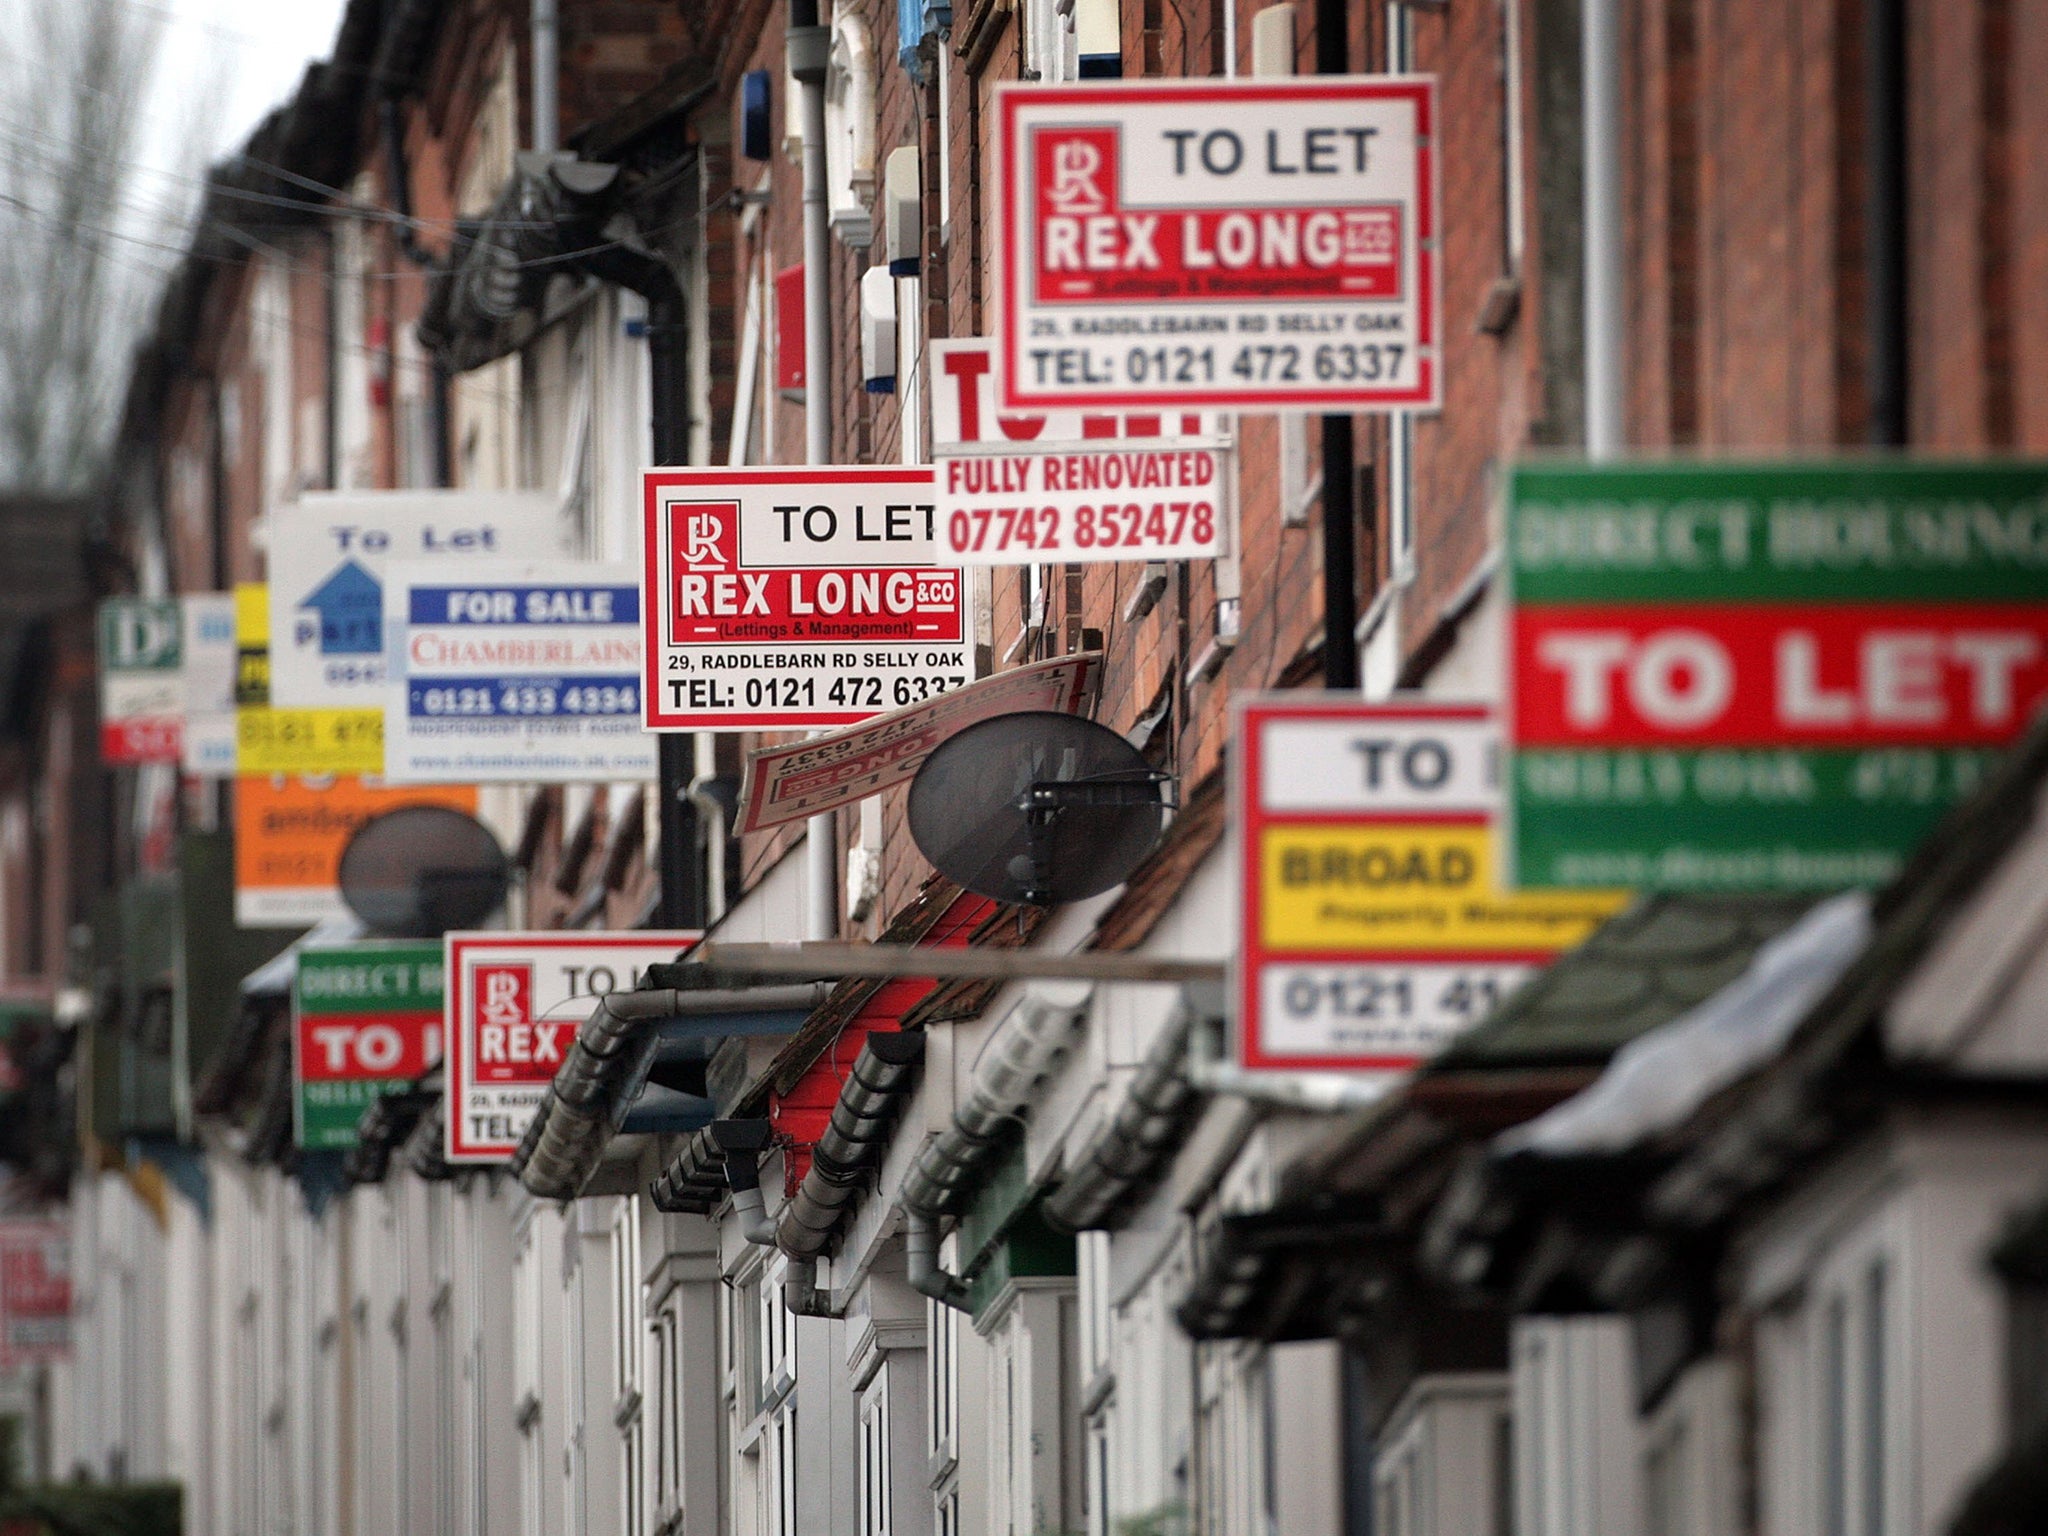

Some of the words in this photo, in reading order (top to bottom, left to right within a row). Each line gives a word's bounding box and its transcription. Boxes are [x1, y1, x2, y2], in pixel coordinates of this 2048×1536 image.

[1163, 129, 1245, 176] TO
[1266, 126, 1378, 174] LET
[1043, 213, 1161, 271] REX
[1181, 210, 1341, 268] LONG
[1029, 349, 1114, 385] TEL:
[1127, 347, 1216, 383] 0121
[1232, 346, 1300, 382] 472
[1315, 344, 1405, 381] 6337
[947, 456, 1031, 495] FULLY
[1043, 450, 1214, 491] RENOVATED
[330, 525, 390, 550] To
[421, 525, 497, 552] Let
[773, 506, 837, 543] TO
[855, 505, 936, 542] LET
[949, 506, 1060, 553] 07742
[1073, 501, 1214, 548] 852478
[1518, 502, 1749, 570] DIRECT
[447, 591, 516, 622] FOR
[525, 591, 614, 622] SALE
[680, 574, 772, 618] REX
[790, 572, 914, 617] LONG
[916, 582, 955, 603] &CO
[718, 623, 787, 640] (Lettings
[792, 623, 802, 636] &
[809, 620, 914, 638] Management)
[668, 655, 695, 673] 29,
[702, 653, 826, 670] RADDLEBARN
[833, 653, 857, 669] RD
[863, 652, 919, 668] SELLY
[925, 652, 965, 667] OAK
[1537, 629, 1737, 729] TO
[1775, 629, 2040, 727] LET
[500, 686, 557, 714] 433
[561, 685, 638, 713] 4334
[668, 679, 735, 708] TEL:
[745, 678, 815, 707] 0121
[828, 677, 883, 706] 472
[778, 740, 853, 772] 6337
[1352, 737, 1452, 792] TO
[786, 773, 880, 813] LET
[1280, 848, 1475, 887] BROAD
[563, 967, 617, 999] TO
[1284, 979, 1414, 1019] 0121
[312, 1023, 404, 1072] TO
[480, 1024, 559, 1063] REX
